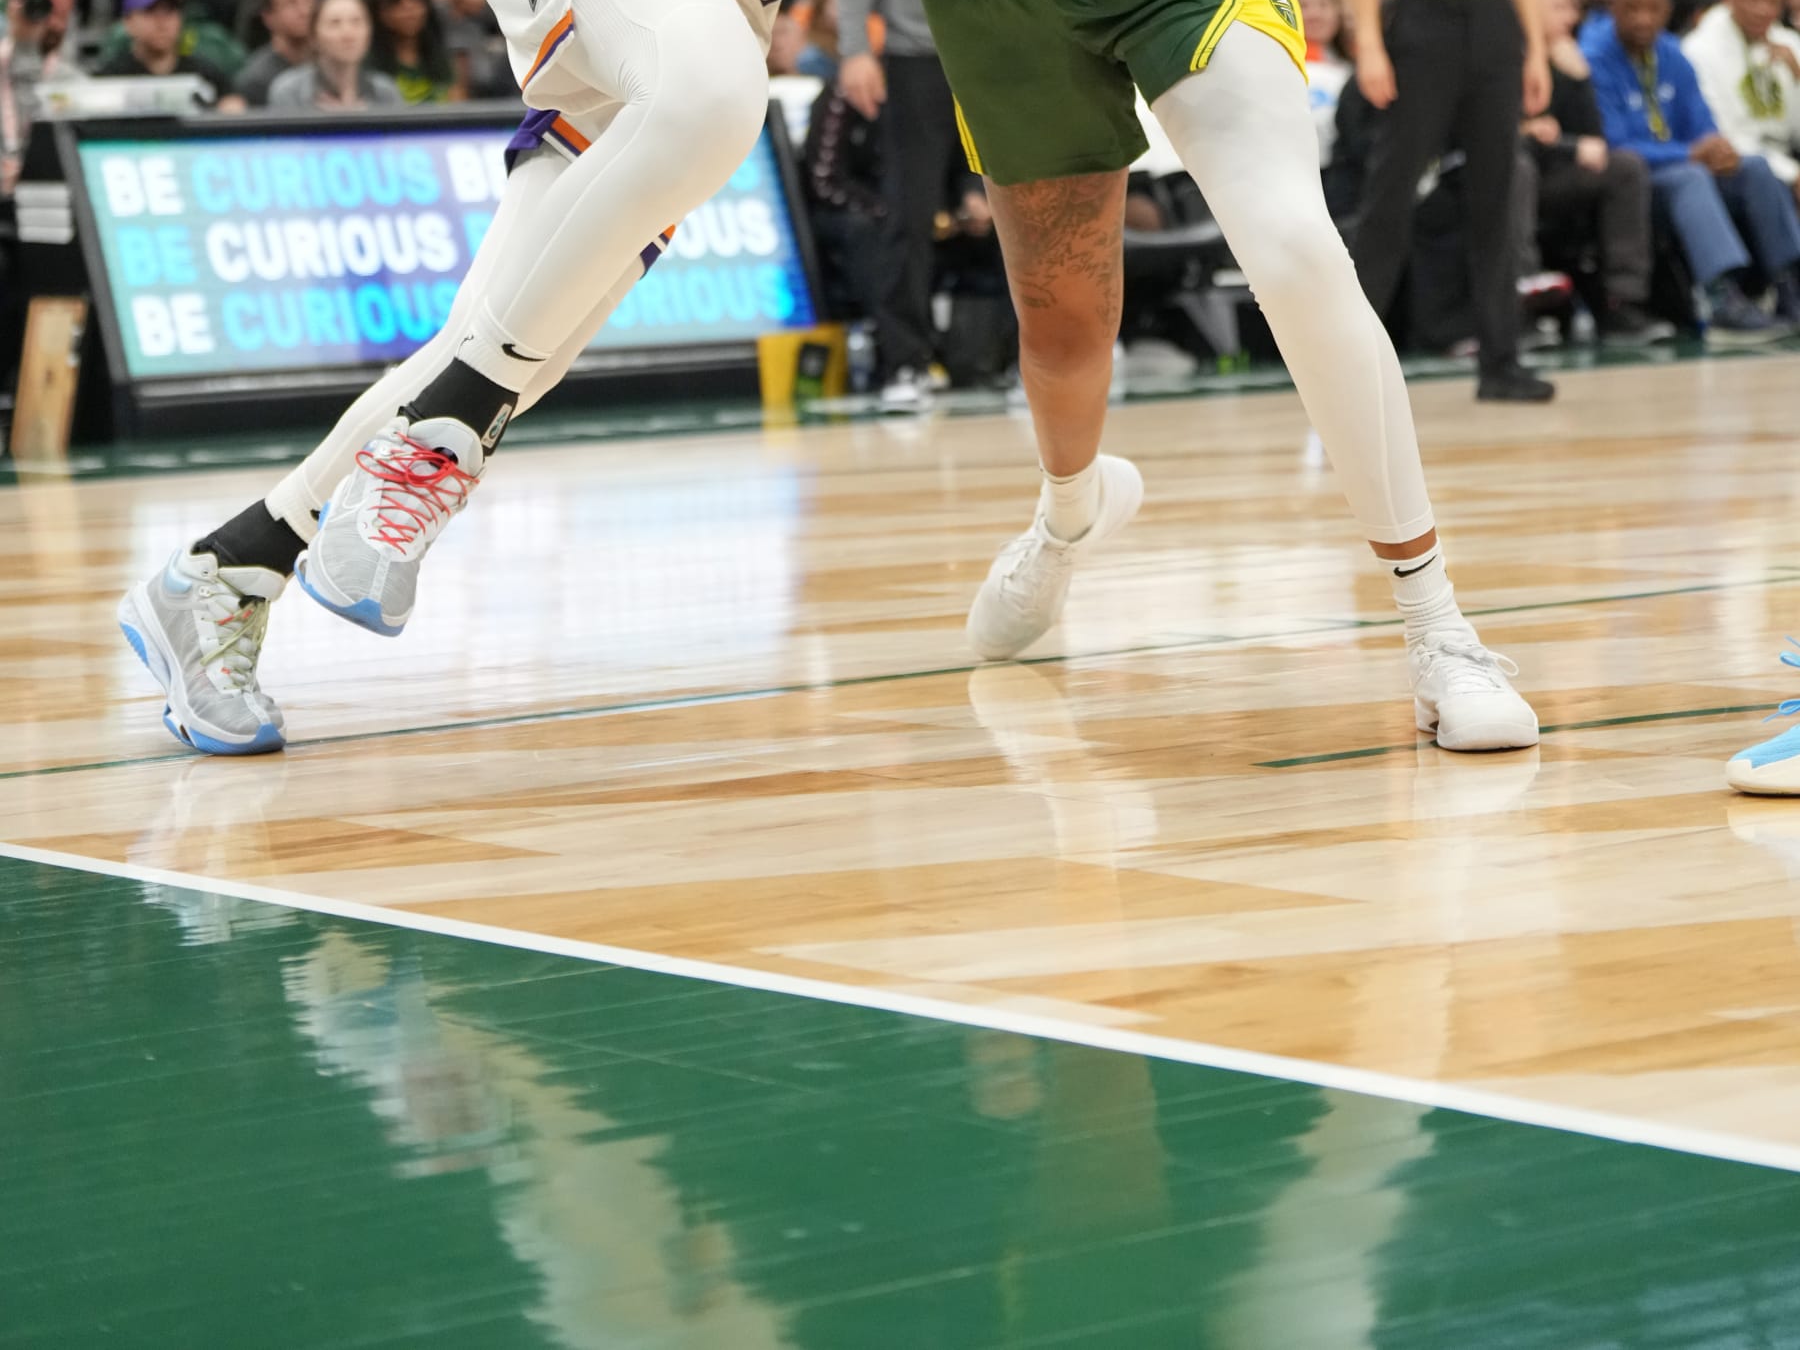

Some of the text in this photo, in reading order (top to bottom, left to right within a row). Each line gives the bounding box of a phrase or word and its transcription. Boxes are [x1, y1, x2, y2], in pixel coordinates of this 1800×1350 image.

[102, 155, 184, 217] BE
[190, 147, 441, 213] CURIOUS
[116, 224, 197, 287] BE
[205, 211, 458, 283] CURIOUS
[130, 292, 215, 357] BE
